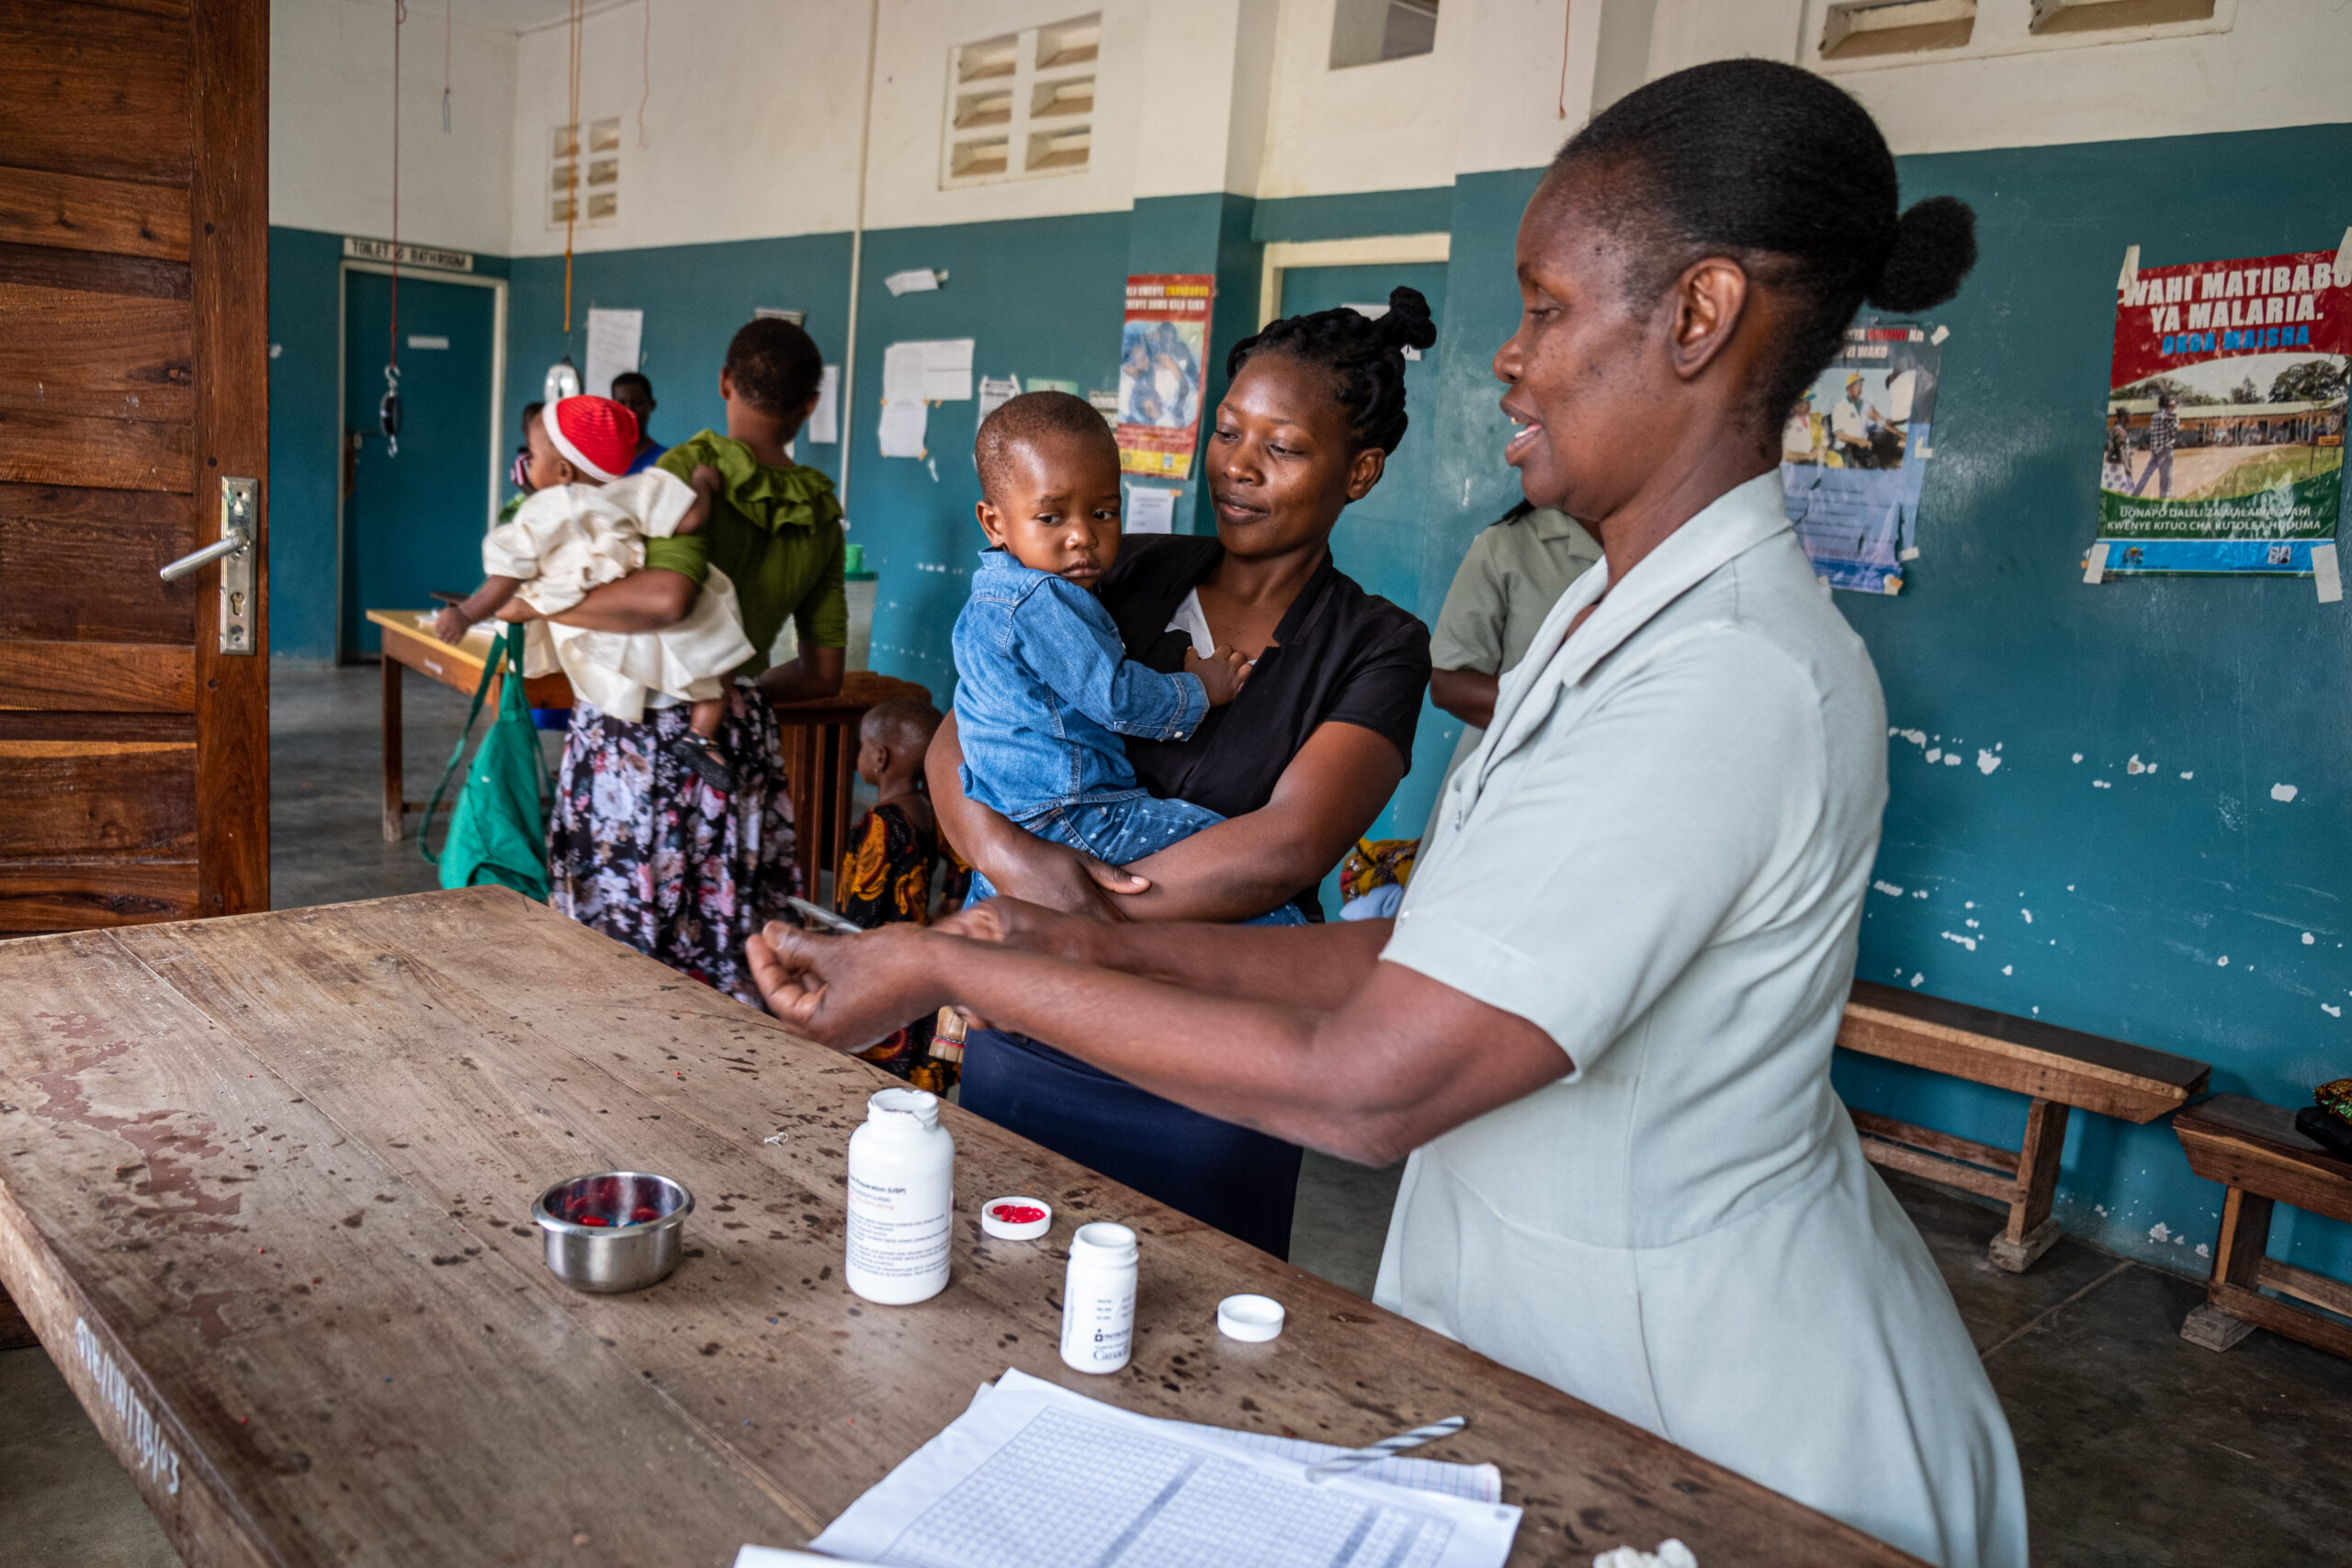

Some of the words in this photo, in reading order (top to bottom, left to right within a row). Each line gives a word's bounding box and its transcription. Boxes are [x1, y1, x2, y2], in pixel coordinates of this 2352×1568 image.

[2124, 276, 2194, 307] WAHI
[2201, 262, 2352, 299] MATIBABU
[2151, 305, 2180, 333] YA
[2188, 294, 2324, 330] MALARIA.
[1908, 329, 1924, 342] NA
[2162, 333, 2215, 355] OKOA
[2223, 325, 2310, 350] MAISHA
[1857, 345, 1888, 358] WAKO
[2120, 508, 2167, 518] UONAPO
[2169, 508, 2203, 518] DALILI
[2108, 521, 2151, 531] KWENYE
[2154, 521, 2187, 531] KITUO
[2189, 521, 2211, 531] CHA
[2268, 520, 2321, 530] HUDUMA
